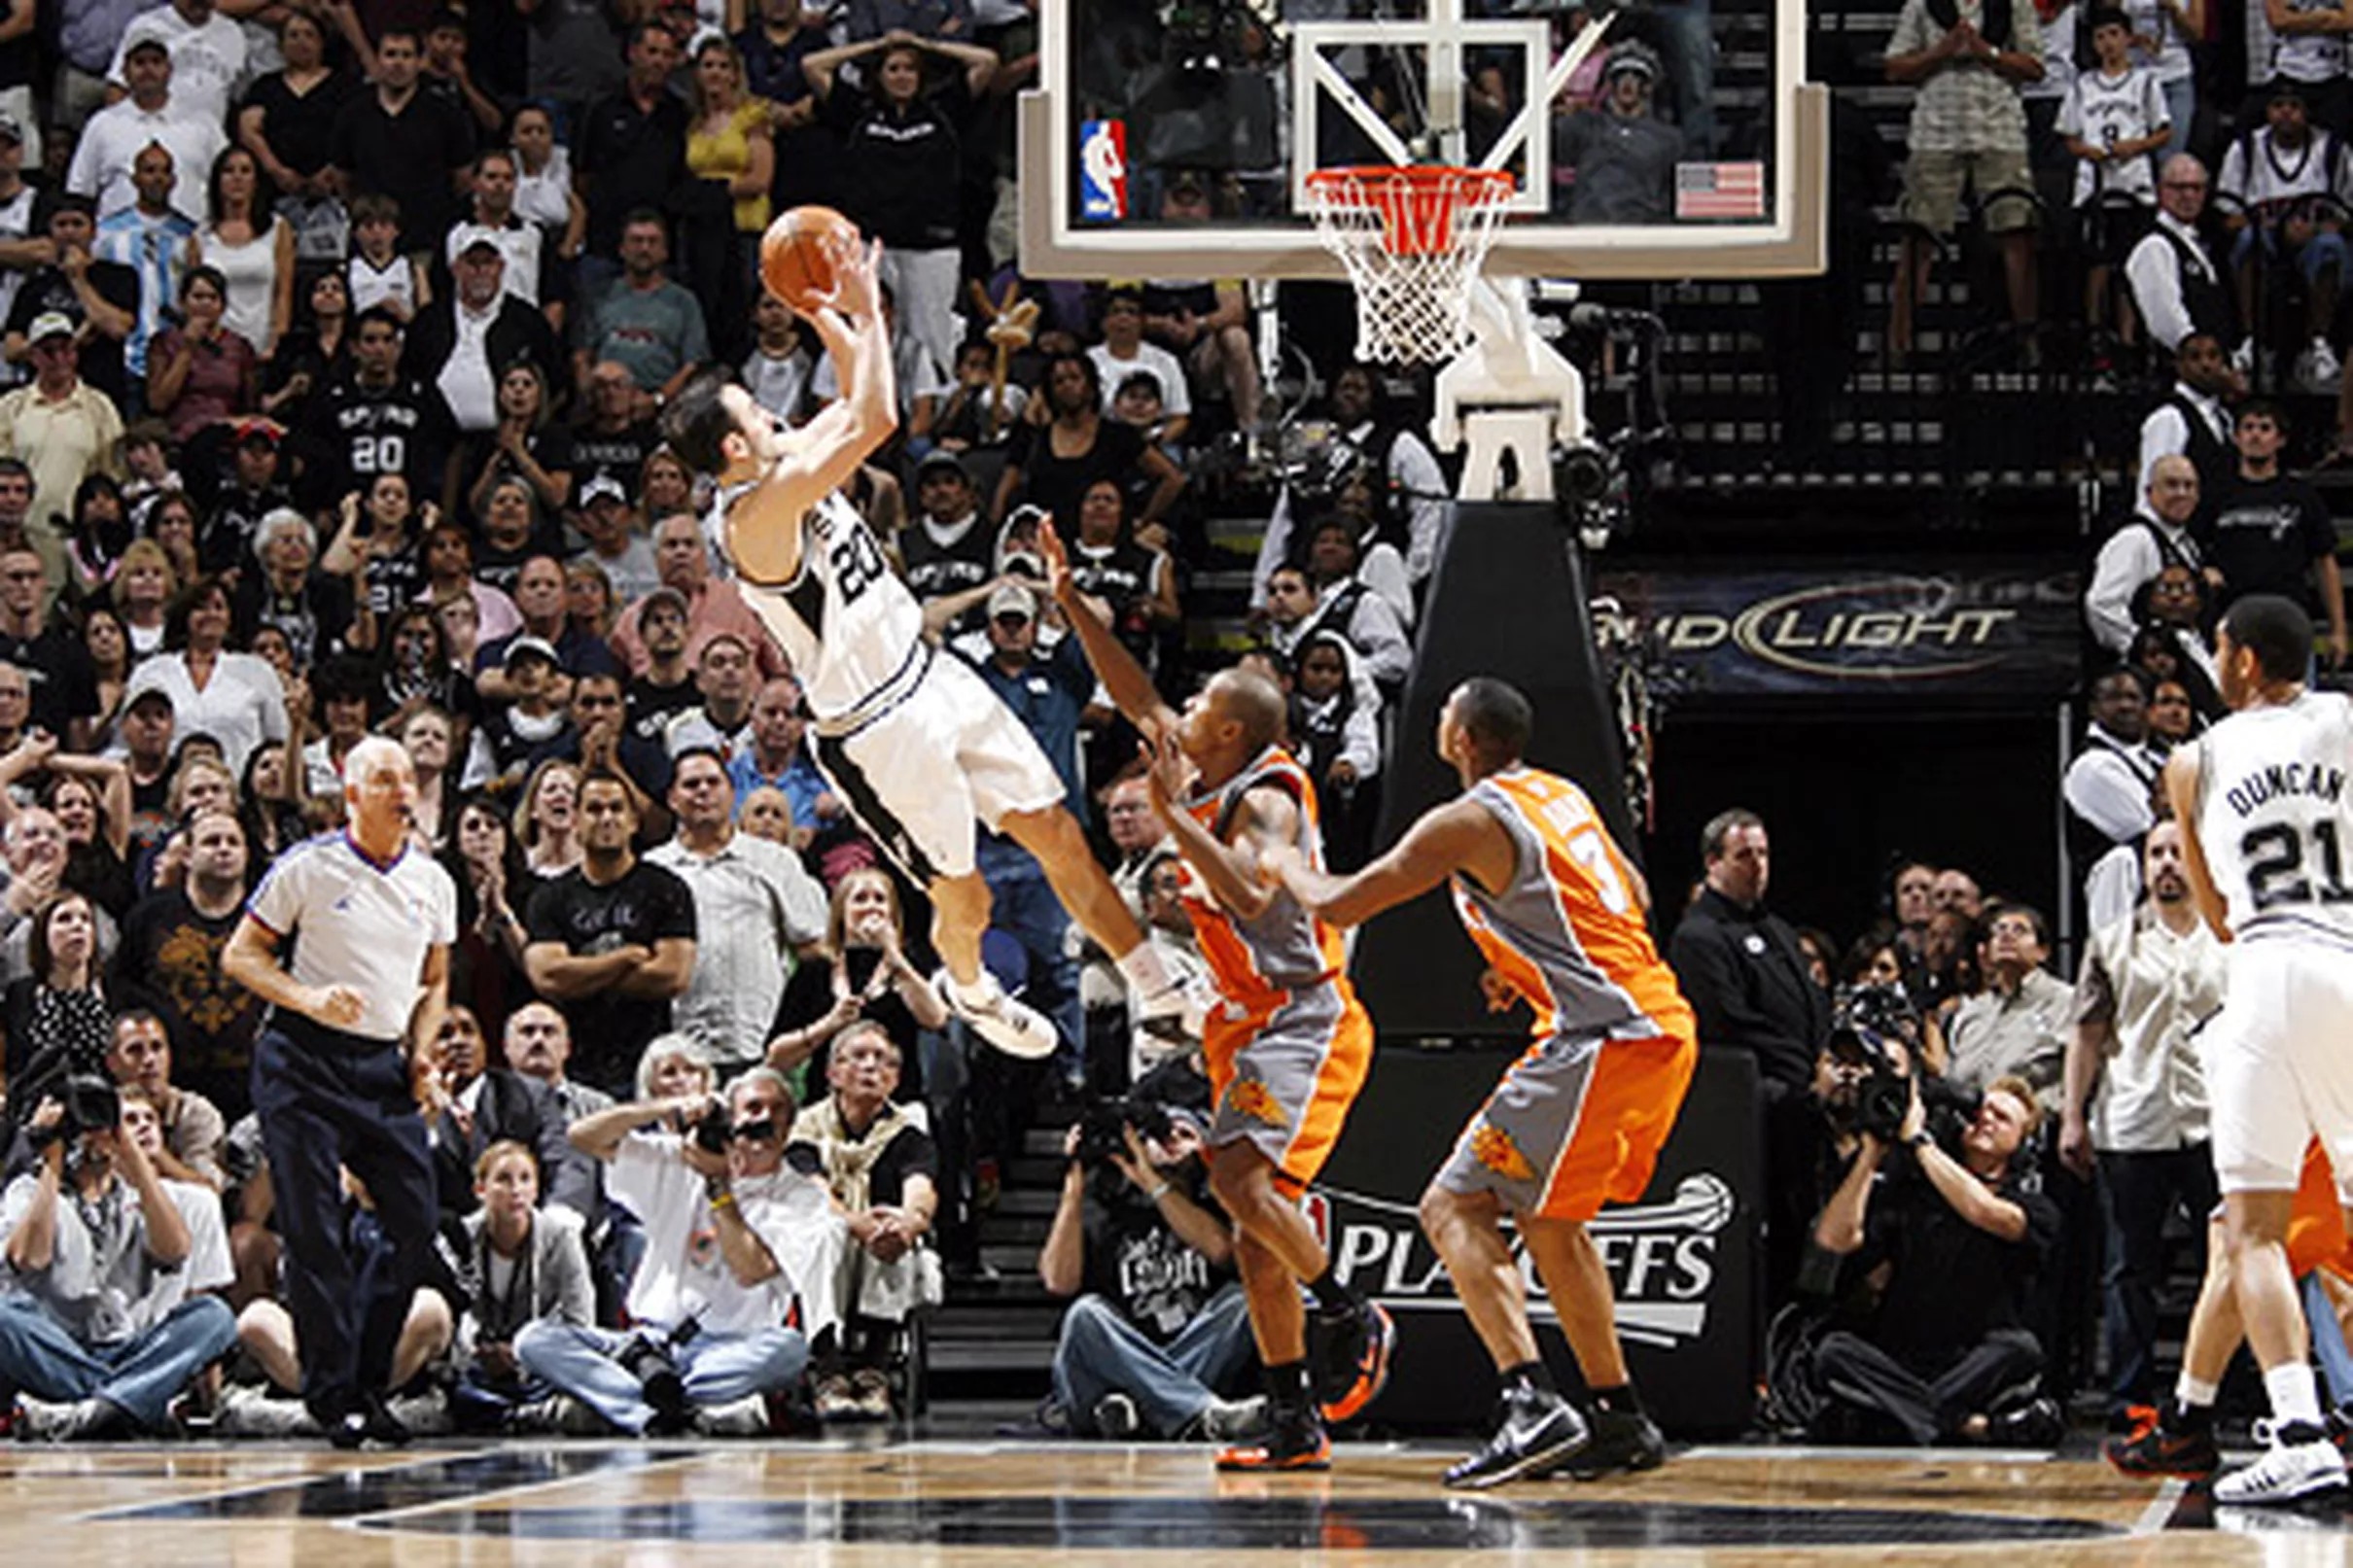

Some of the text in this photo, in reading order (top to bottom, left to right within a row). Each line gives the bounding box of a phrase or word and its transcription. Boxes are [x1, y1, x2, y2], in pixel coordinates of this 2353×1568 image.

[352, 435, 404, 472] 20
[830, 523, 884, 605] 20
[1772, 609, 2017, 646] LIGHT
[2227, 762, 2347, 818] DUNCAN
[2241, 820, 2353, 912] 21
[1333, 1224, 1715, 1300] PLFFS
